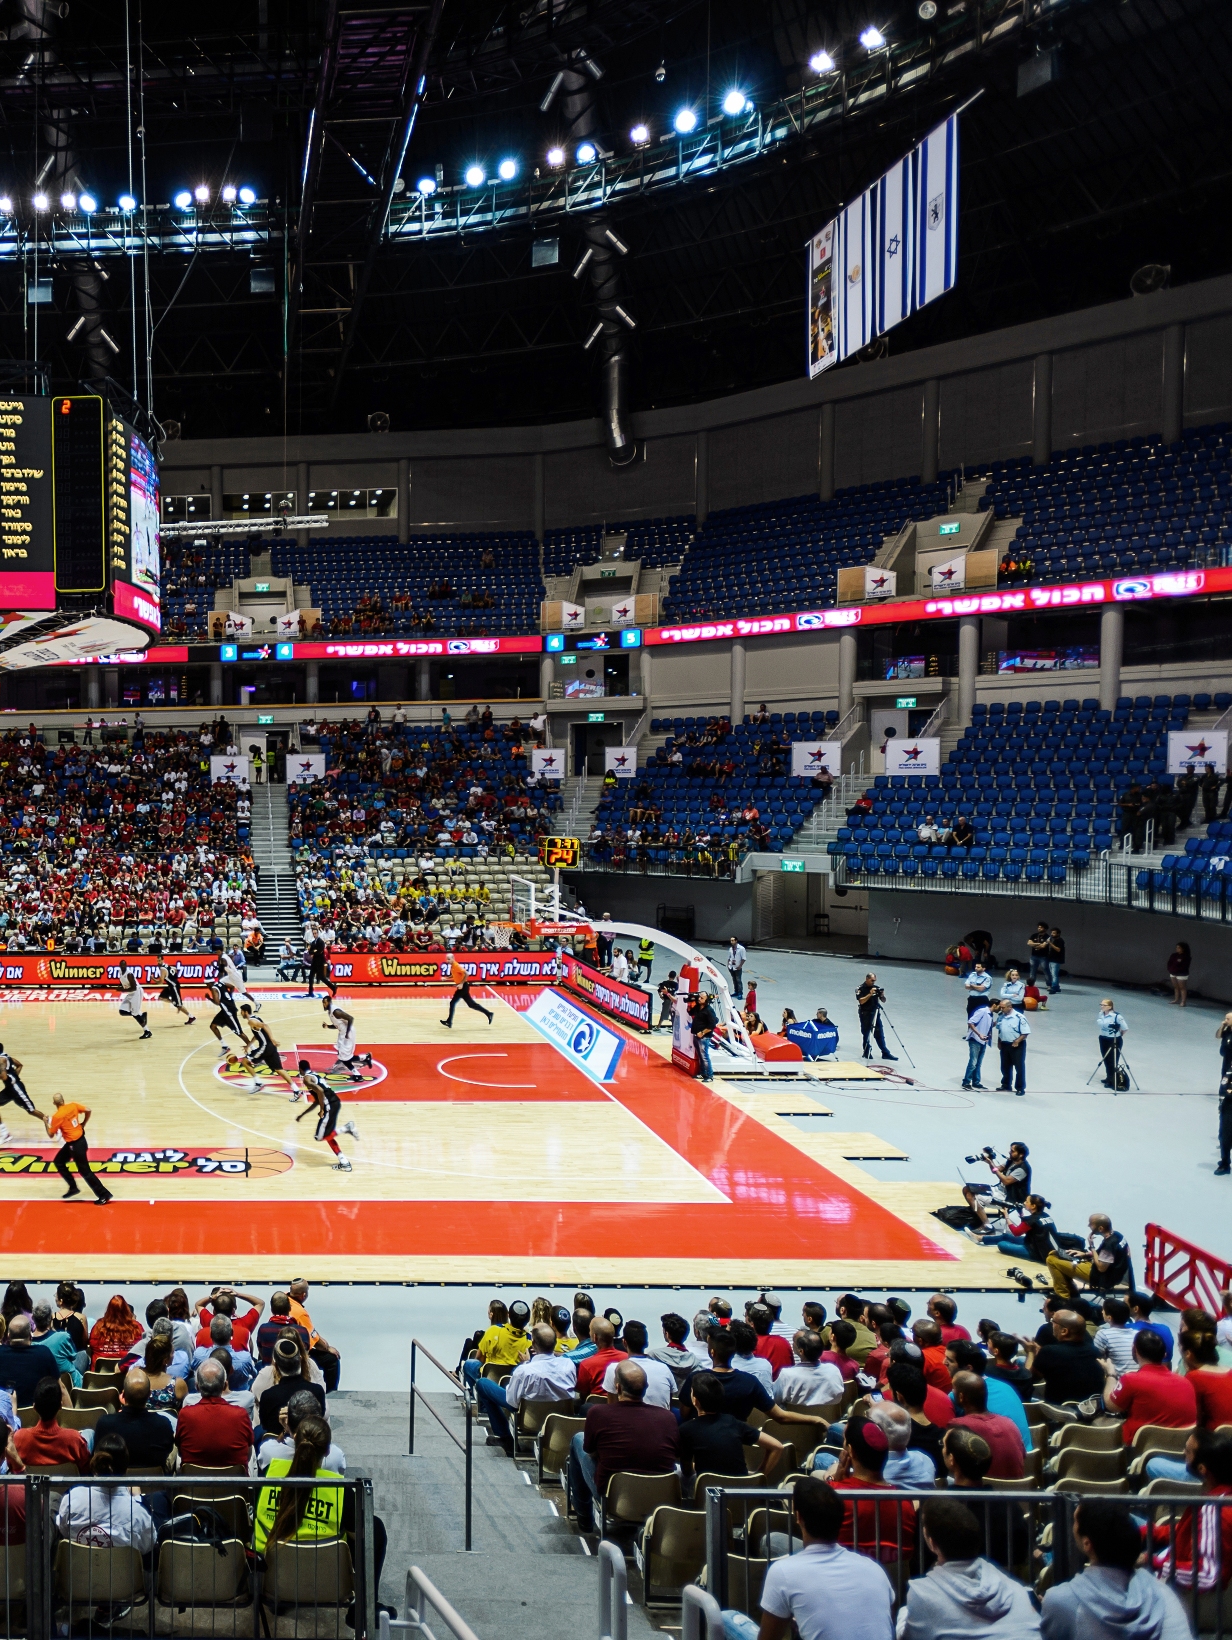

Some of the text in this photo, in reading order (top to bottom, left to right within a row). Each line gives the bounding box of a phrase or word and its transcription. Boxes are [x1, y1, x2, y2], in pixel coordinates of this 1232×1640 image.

[62, 400, 71, 413] 2
[926, 584, 1105, 615] הכול אפשרי
[661, 617, 790, 641] הכול אפשרי
[550, 637, 559, 648] 4
[627, 633, 635, 643] 5
[225, 647, 233, 657] 3
[281, 646, 289, 655] 4
[327, 644, 393, 655] אפשרי
[396, 641, 442, 653] הכול
[49, 960, 104, 979] Winner
[334, 964, 352, 976] אם
[381, 957, 438, 976] Winner
[480, 961, 499, 980] איך
[541, 957, 558, 974] לא
[7, 966, 23, 979] אם
[576, 964, 595, 993] Winner
[789, 1028, 812, 1039] molten
[818, 1030, 837, 1039] molten
[112, 1149, 185, 1163] ליגת
[197, 1158, 247, 1173] סל
[268, 1489, 334, 1520] PECT
